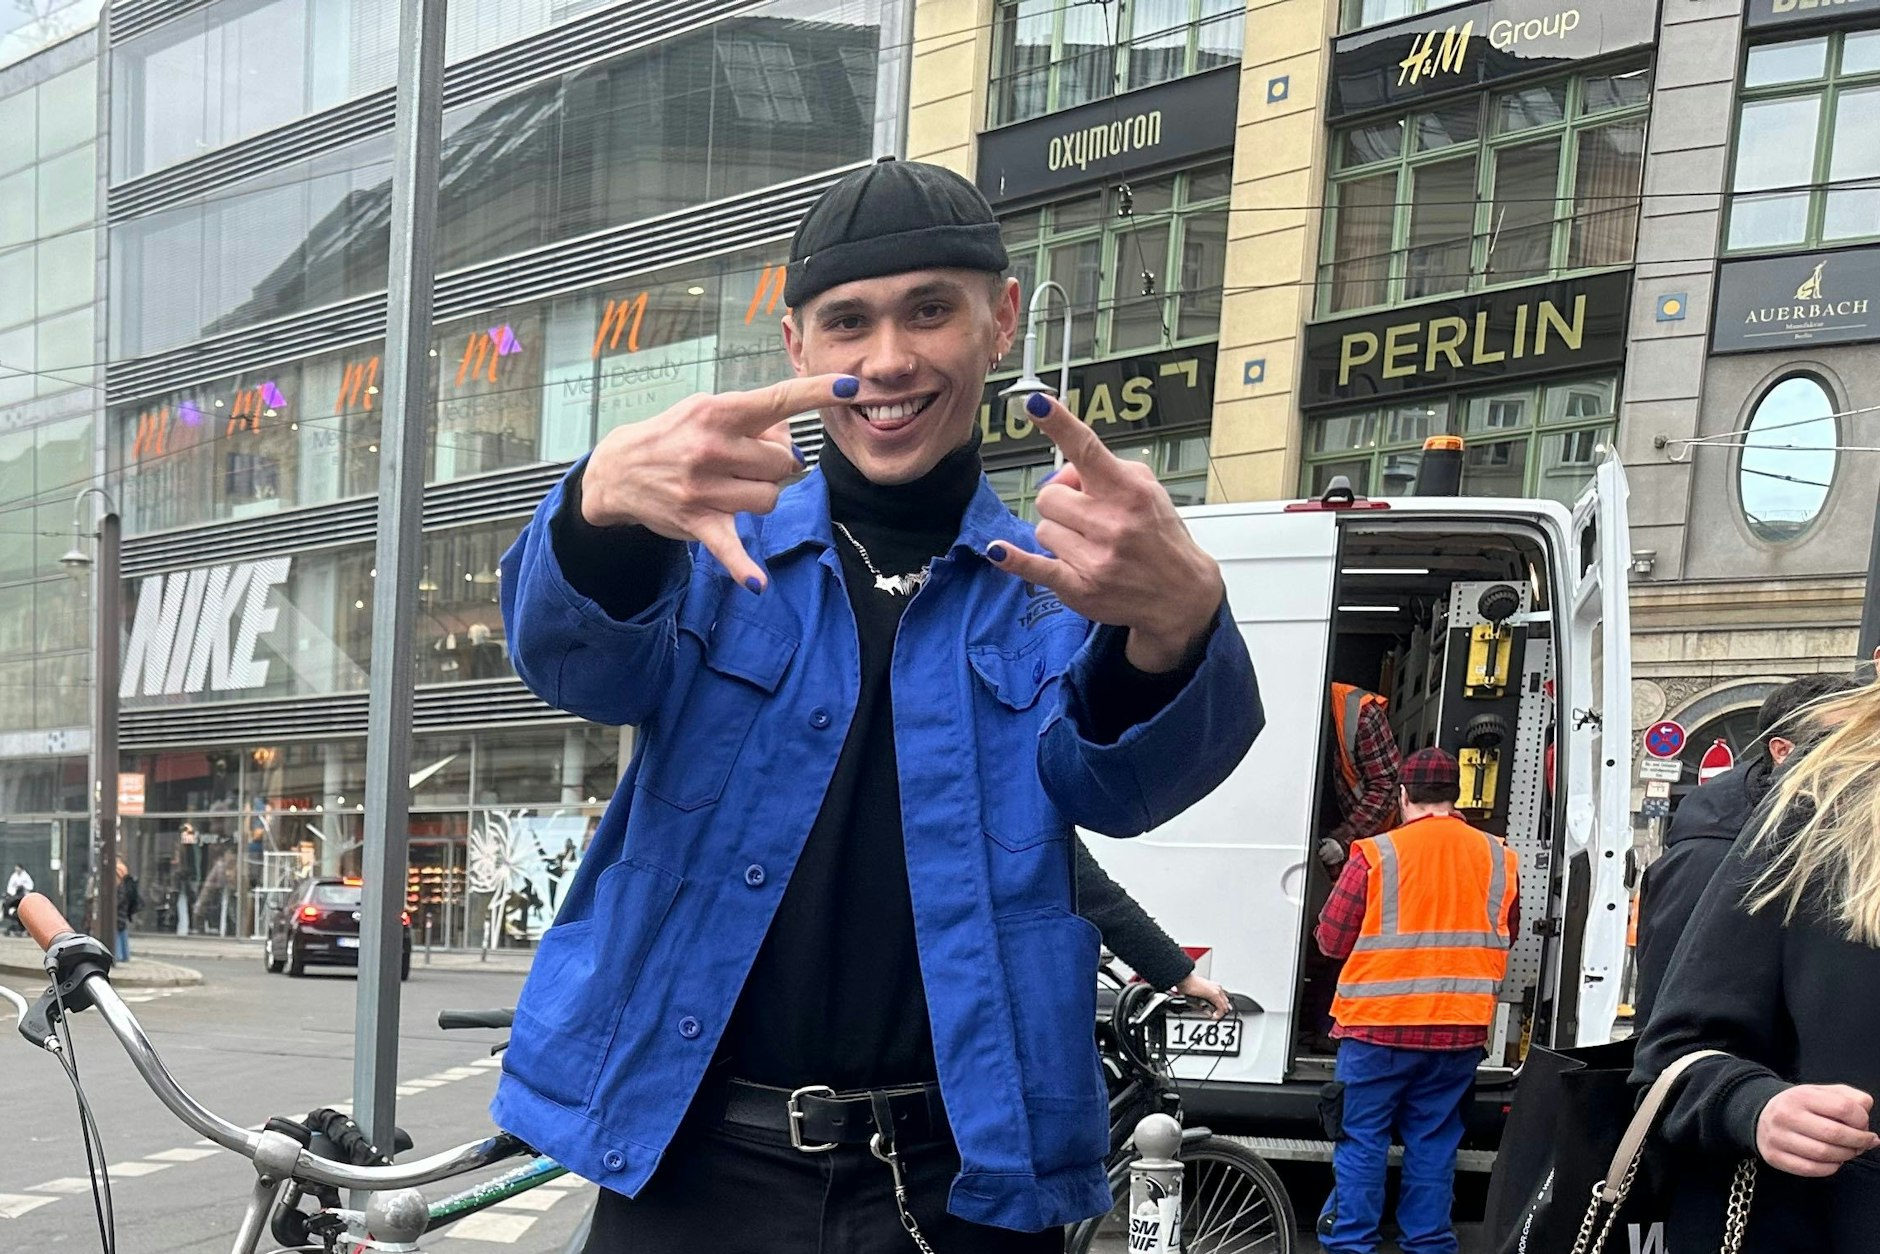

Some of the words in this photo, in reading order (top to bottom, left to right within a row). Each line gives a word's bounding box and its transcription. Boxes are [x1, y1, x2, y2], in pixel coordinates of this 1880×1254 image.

[1398, 20, 1474, 87] H&M
[1489, 9, 1579, 50] Group
[1048, 110, 1161, 172] oxymoron
[1338, 294, 1587, 386] PERLIN
[1744, 299, 1868, 324] AUERBACH
[119, 557, 292, 698] NIKE
[1172, 1022, 1236, 1047] 1483
